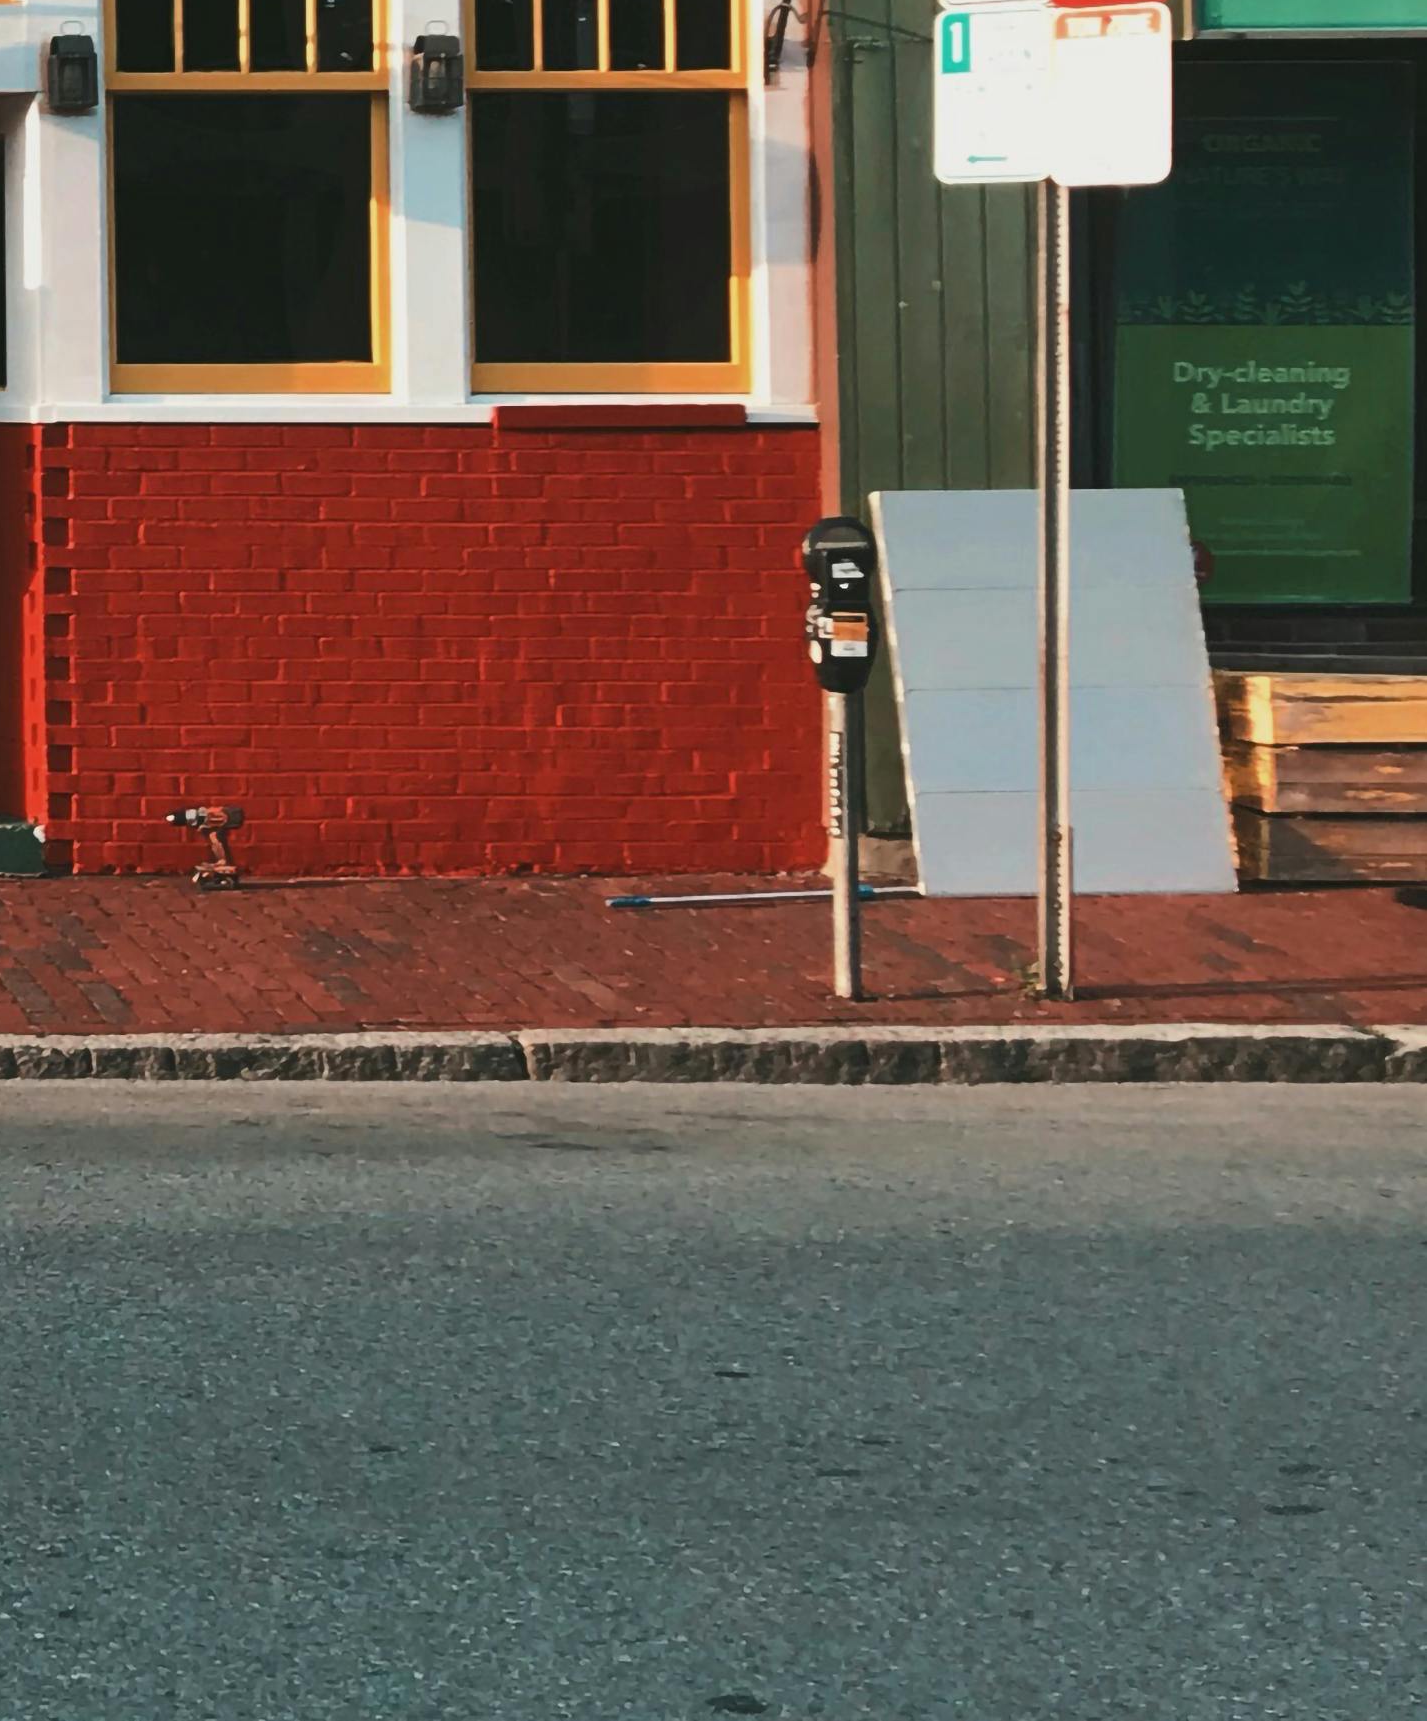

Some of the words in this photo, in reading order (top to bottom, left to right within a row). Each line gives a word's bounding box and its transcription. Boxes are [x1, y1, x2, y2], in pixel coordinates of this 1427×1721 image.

[1173, 360, 1351, 390] Dry-cleaning
[1191, 392, 1212, 414] &
[1221, 392, 1335, 420] Laundry
[1188, 423, 1336, 452] Specialists
